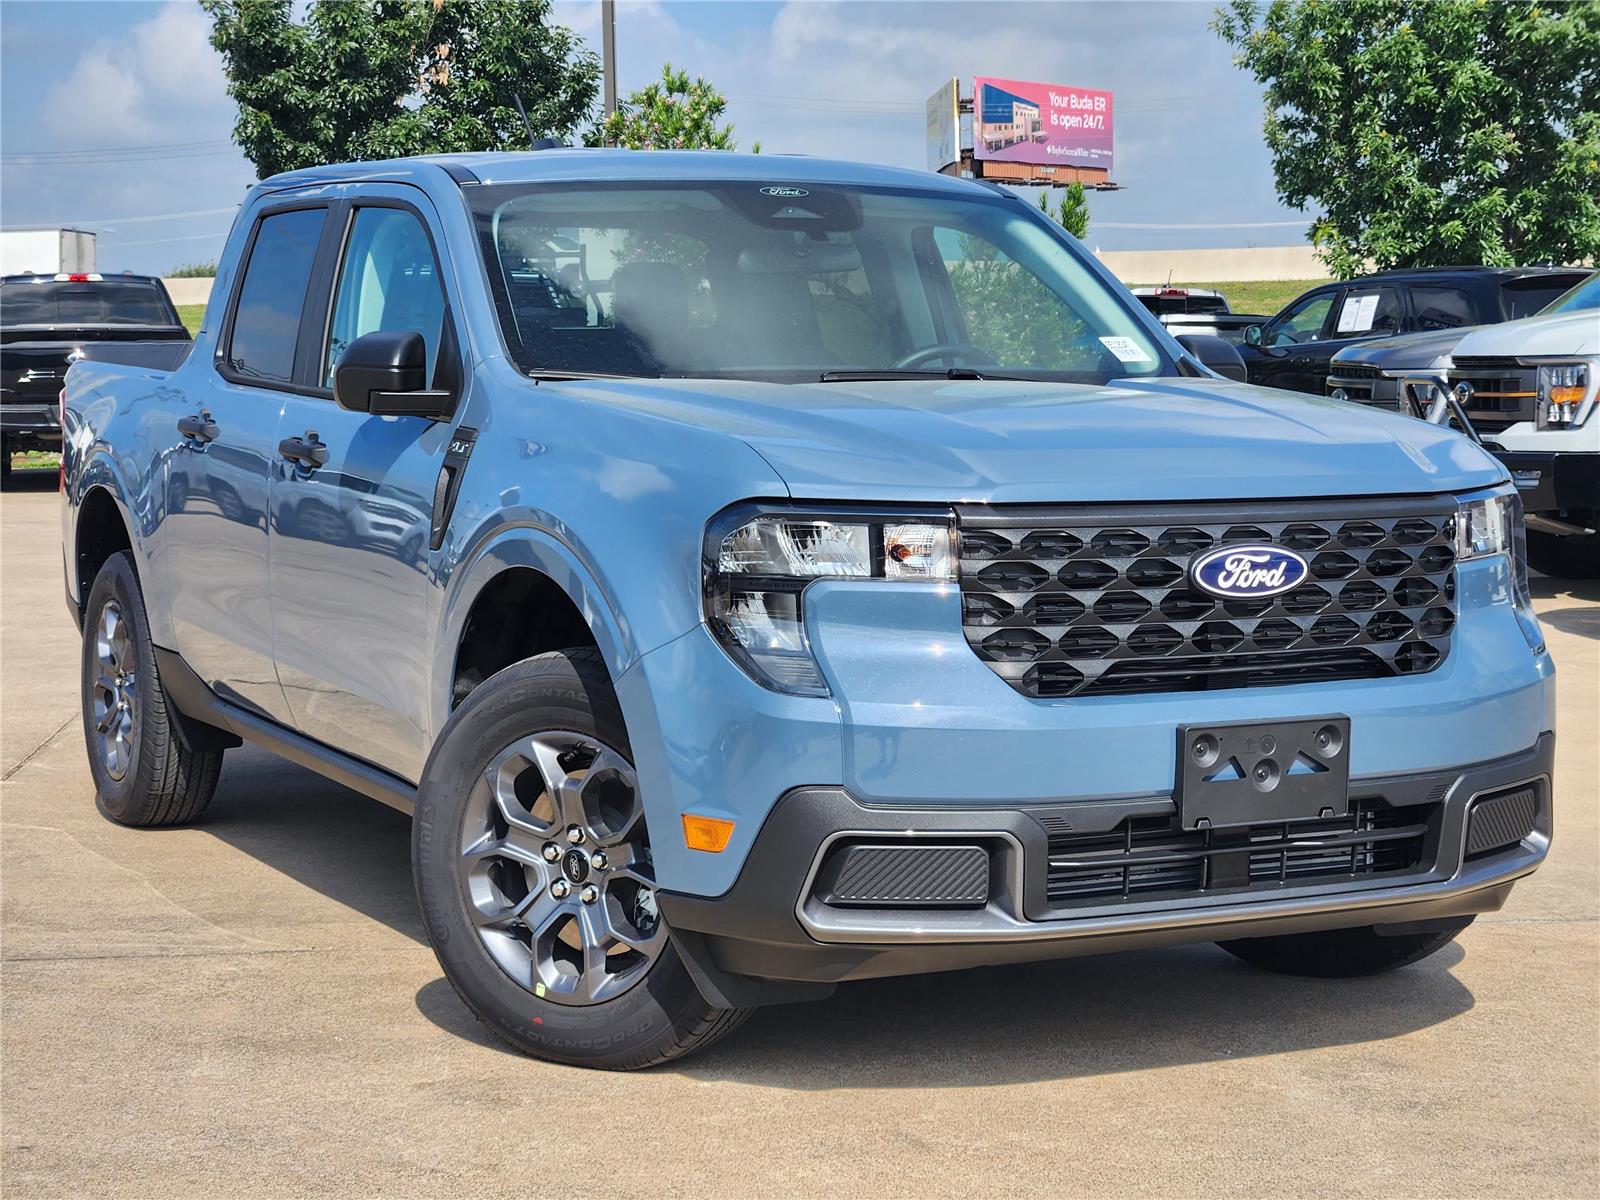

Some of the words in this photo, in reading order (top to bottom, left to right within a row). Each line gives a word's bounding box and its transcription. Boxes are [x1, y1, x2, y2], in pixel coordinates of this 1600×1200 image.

[1049, 92, 1069, 107] Your
[1070, 94, 1093, 110] Buda
[1094, 96, 1105, 112] ER
[1051, 110, 1058, 125] is
[1060, 114, 1082, 130] open
[1083, 114, 1104, 130] 24/7.
[1217, 554, 1287, 588] Ford
